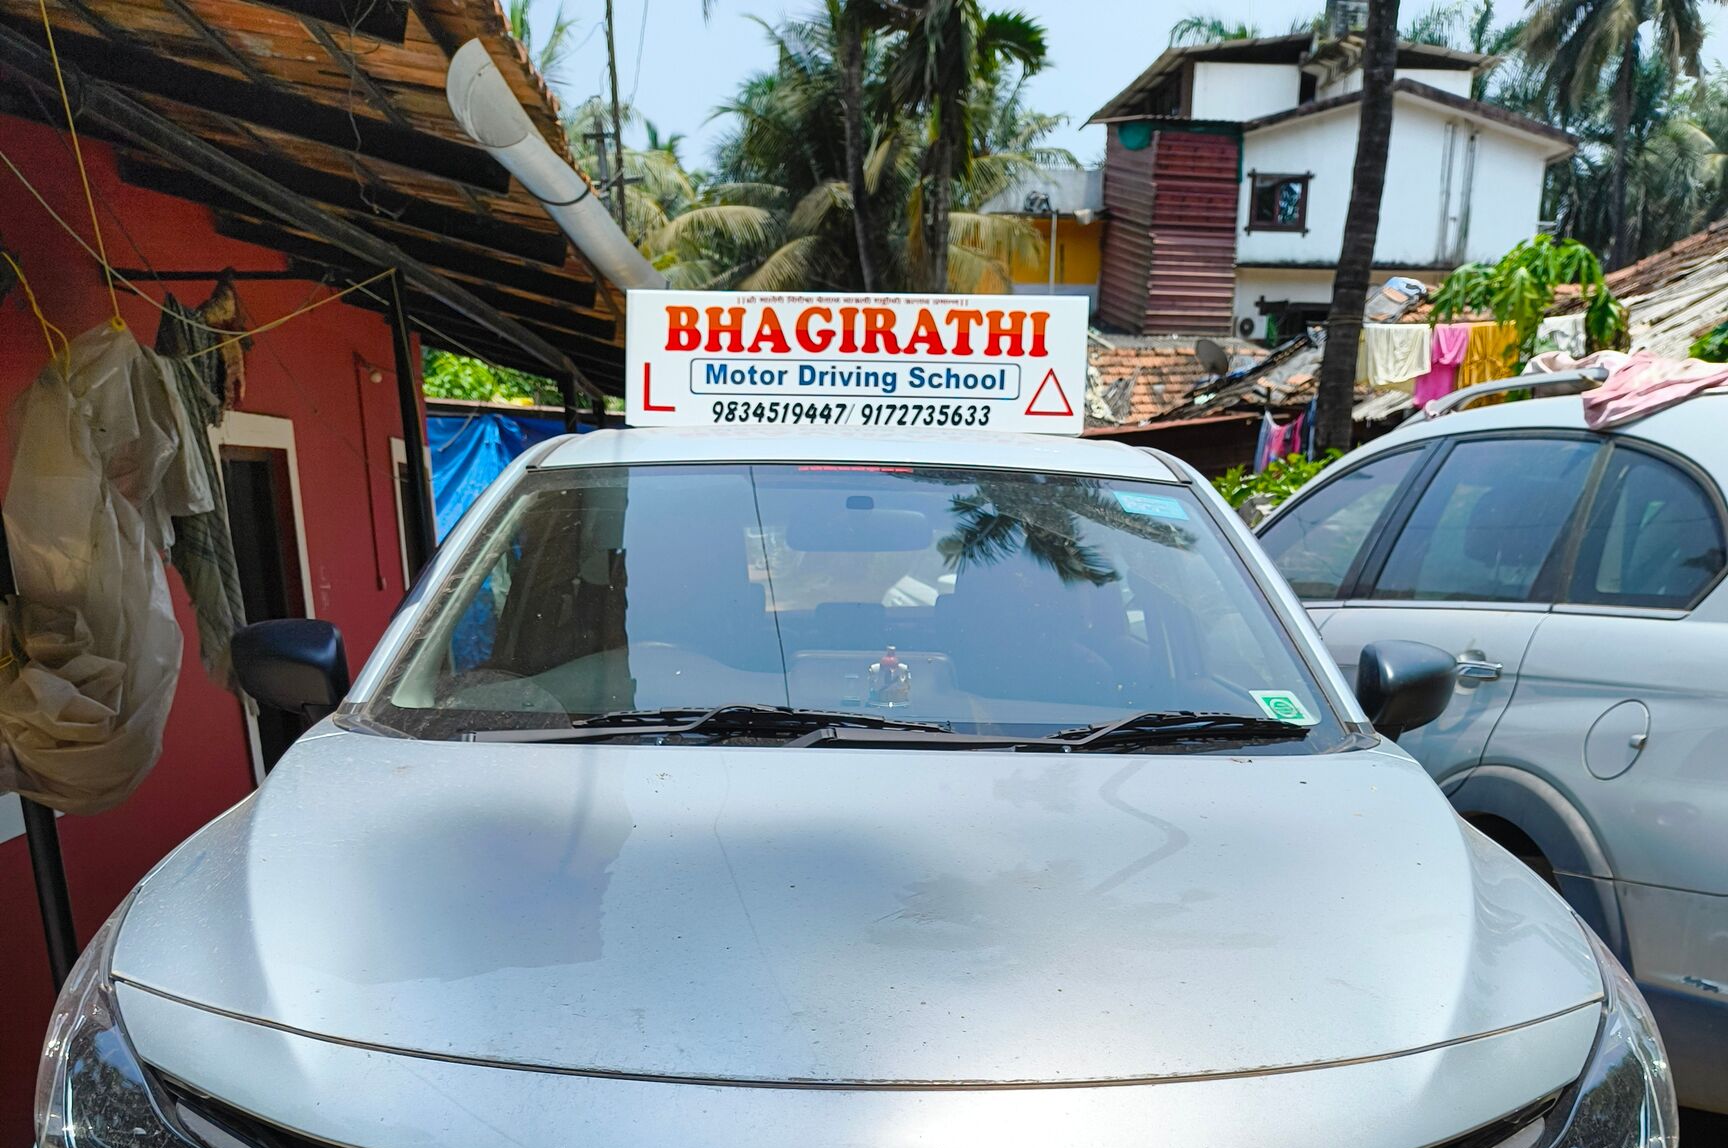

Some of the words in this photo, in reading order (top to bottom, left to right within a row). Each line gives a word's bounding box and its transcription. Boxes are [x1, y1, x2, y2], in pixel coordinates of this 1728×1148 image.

[664, 304, 1050, 358] BHAGIRATHI
[642, 362, 675, 412] L
[705, 363, 788, 387] Motor
[798, 364, 897, 395] Driving
[908, 366, 1006, 391] School
[861, 403, 991, 427] 9172735633
